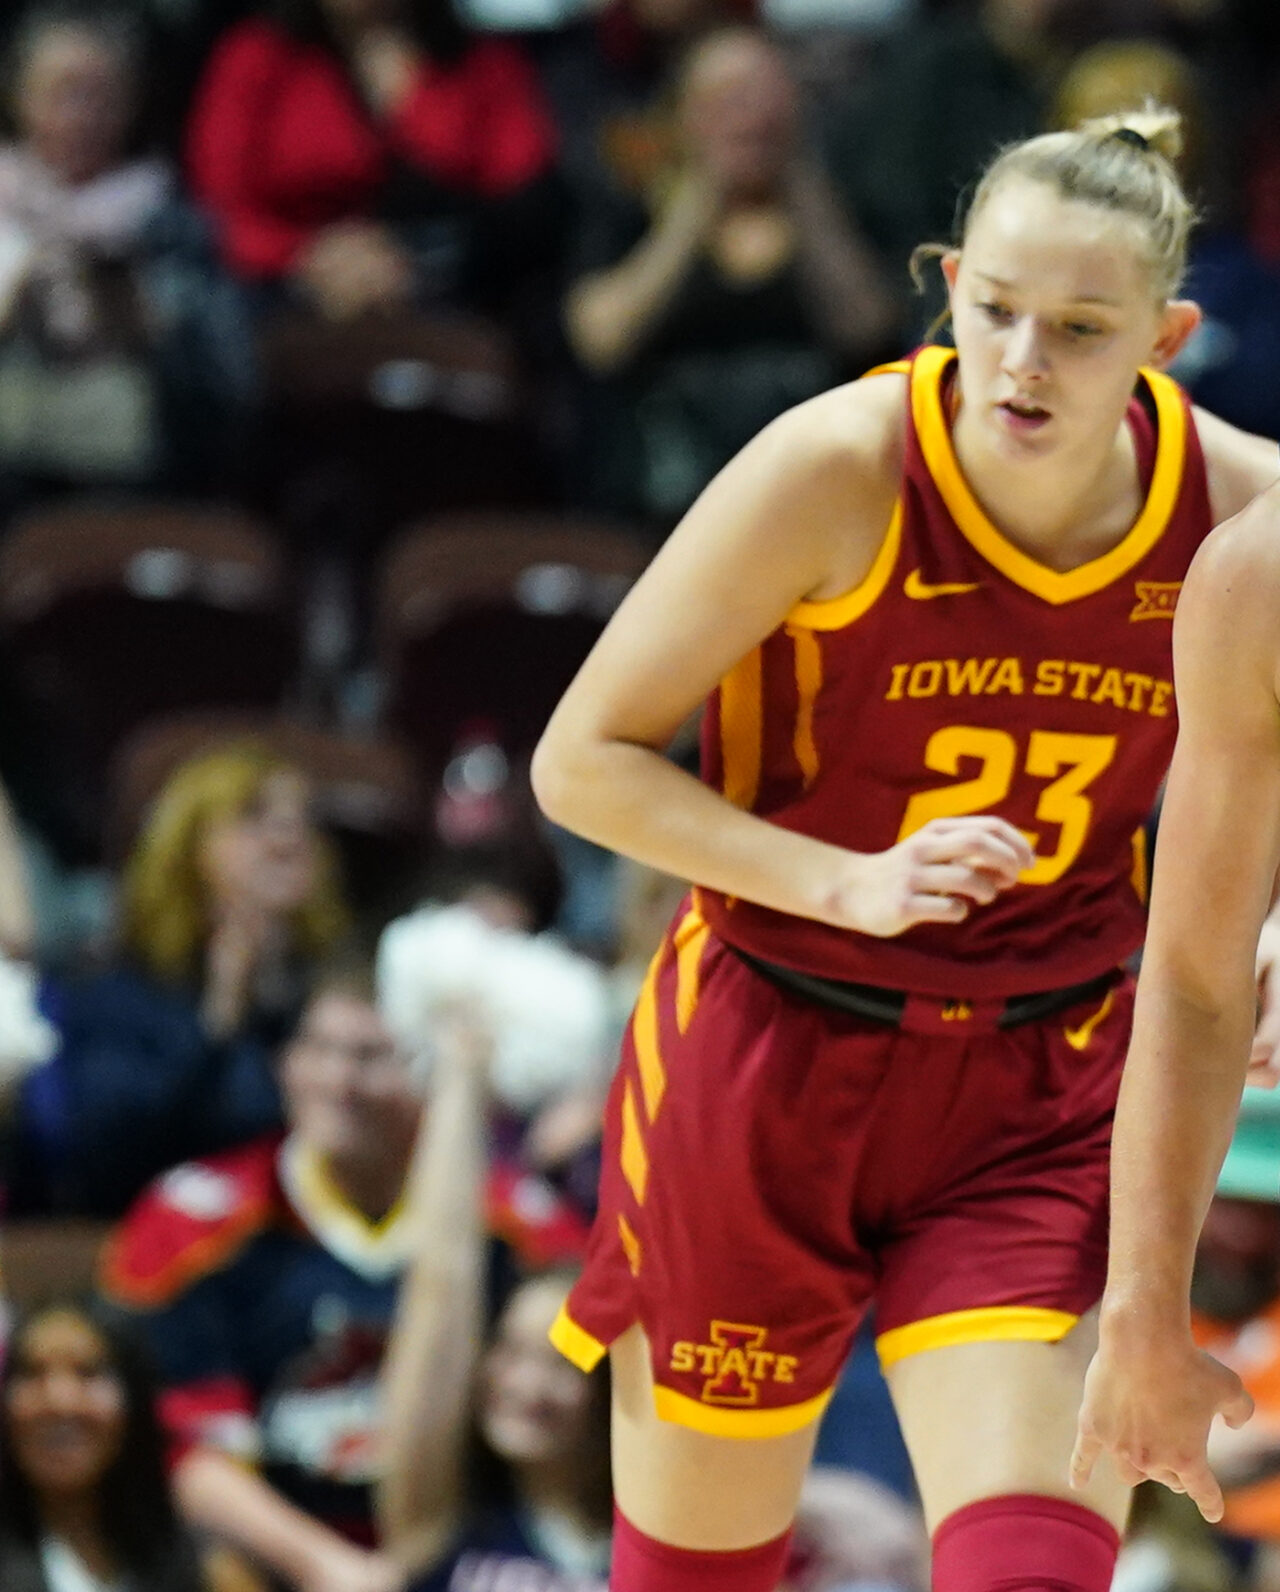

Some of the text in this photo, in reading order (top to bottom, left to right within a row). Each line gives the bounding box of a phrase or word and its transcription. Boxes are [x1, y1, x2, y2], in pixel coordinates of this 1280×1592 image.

[885, 657, 1174, 718] IOWA STATE
[896, 724, 1118, 886] 23
[670, 1340, 799, 1383] STATE
